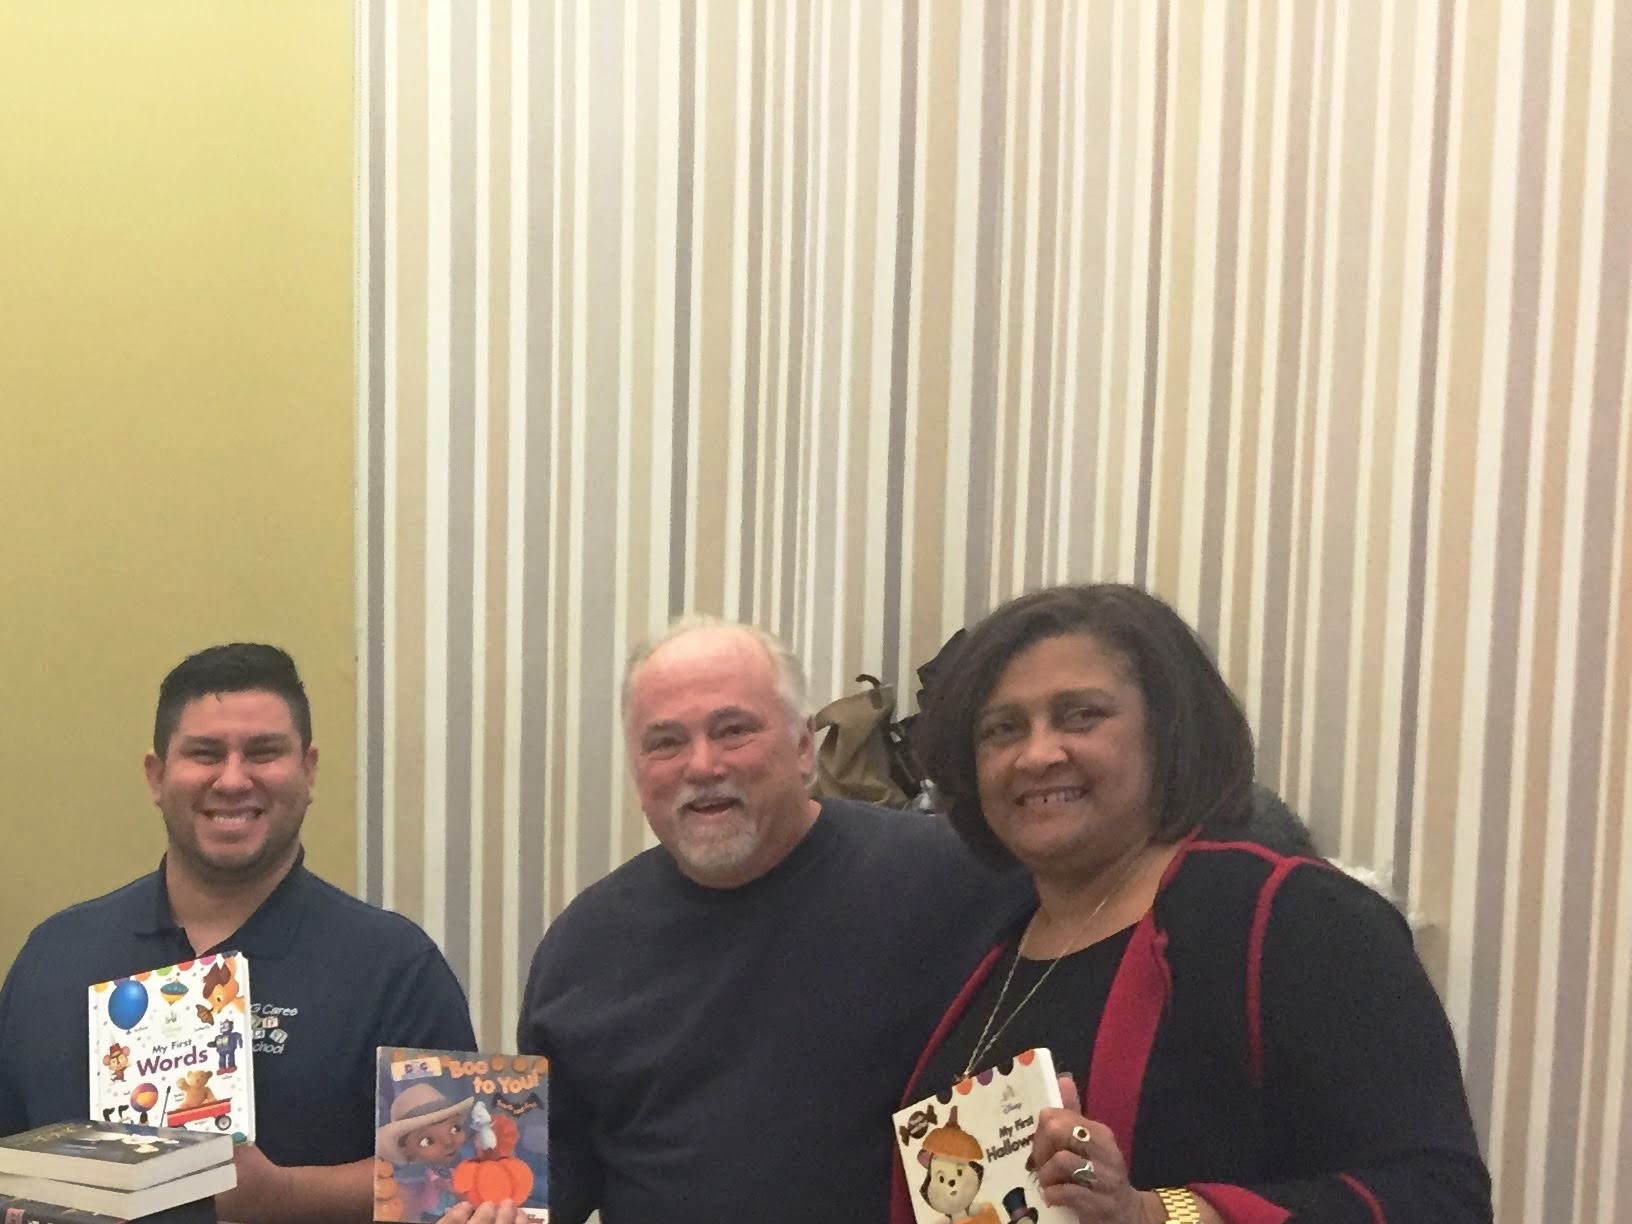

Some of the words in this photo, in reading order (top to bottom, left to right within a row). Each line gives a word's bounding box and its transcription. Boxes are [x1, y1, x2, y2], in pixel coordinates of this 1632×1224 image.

[152, 1044, 168, 1055] My
[171, 1038, 192, 1050] First
[252, 1041, 285, 1054] chool
[137, 1046, 208, 1077] Words
[986, 1135, 1034, 1163] Hallow
